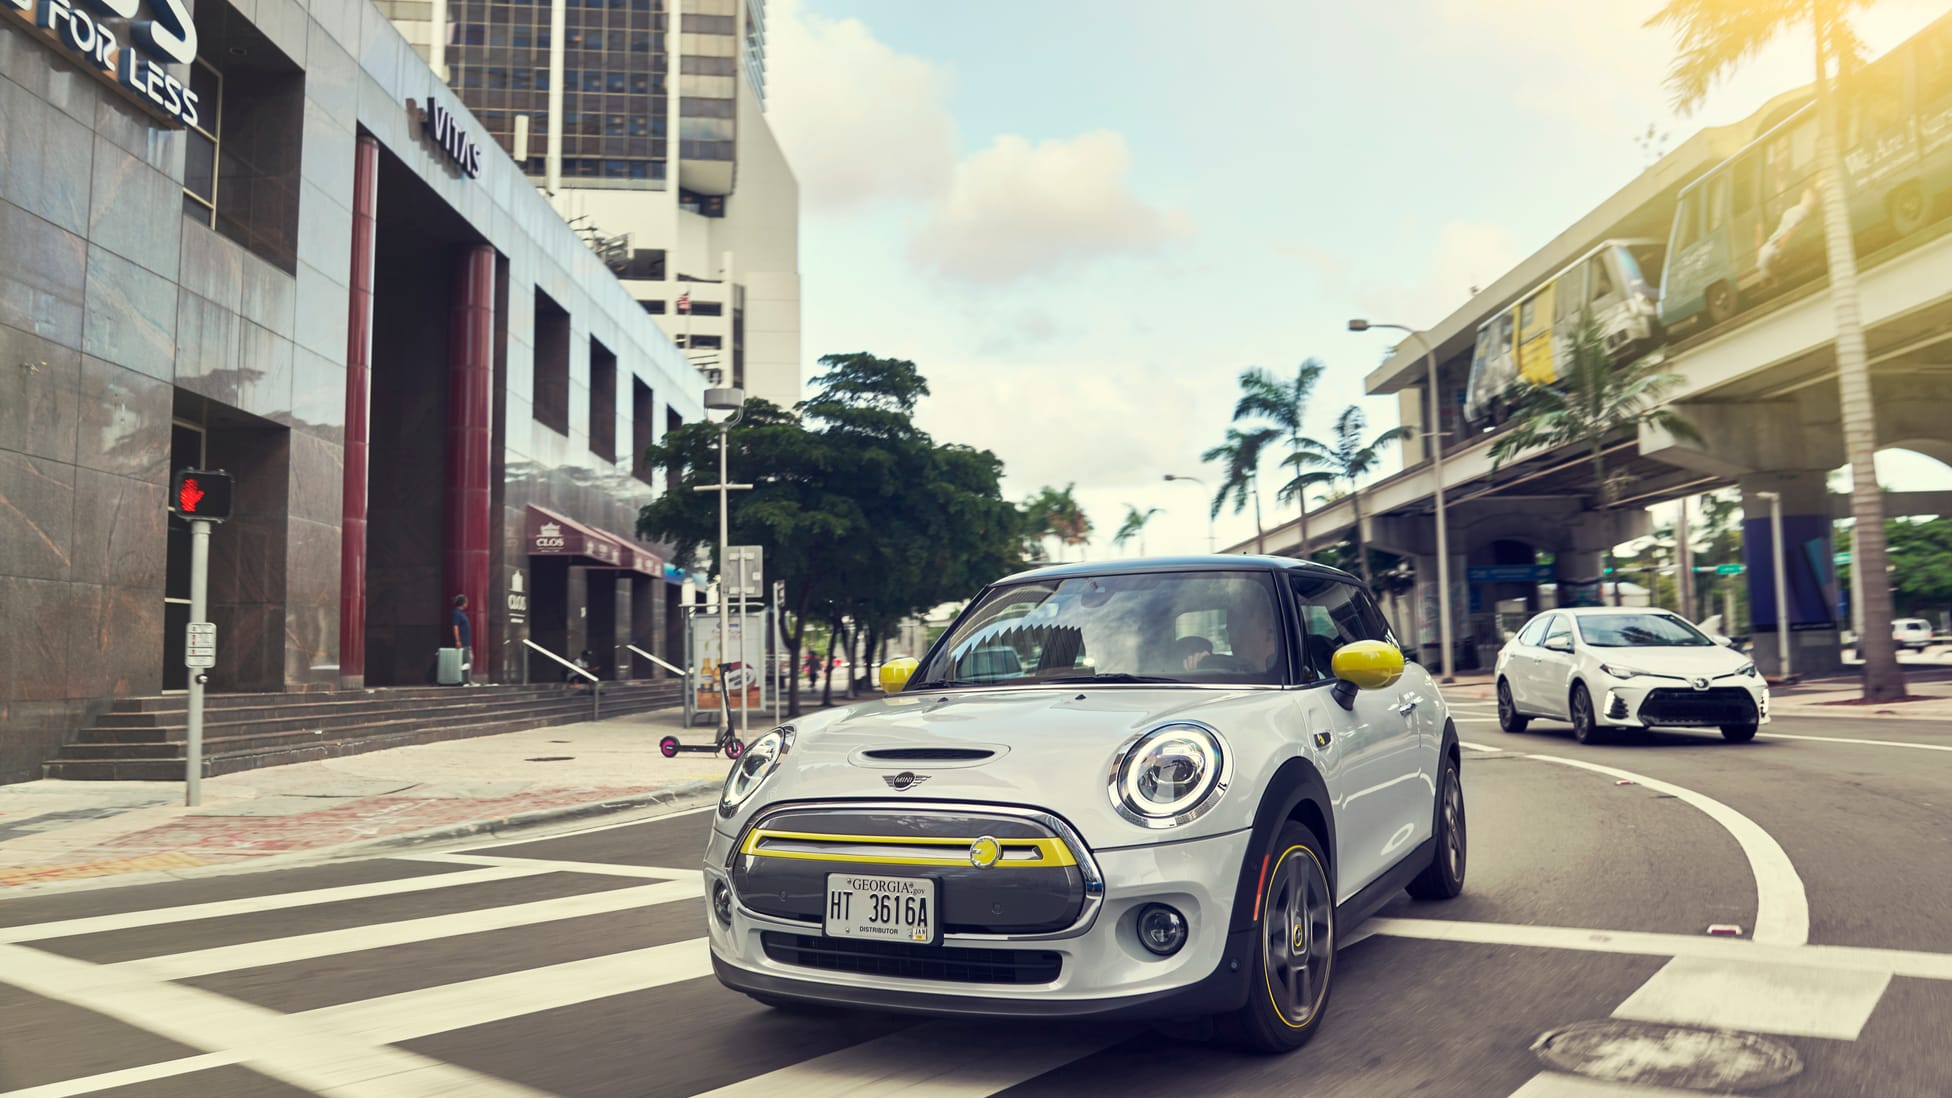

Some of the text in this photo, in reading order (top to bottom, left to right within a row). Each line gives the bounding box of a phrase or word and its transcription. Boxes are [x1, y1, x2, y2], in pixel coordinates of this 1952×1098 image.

[48, 0, 117, 72] FOR
[129, 47, 199, 127] LESS
[431, 97, 481, 179] VITAS
[535, 538, 565, 548] CLOS
[895, 775, 914, 784] MINI
[830, 890, 928, 927] HT 3616A
[859, 926, 899, 935] DISTRIBUTOR
